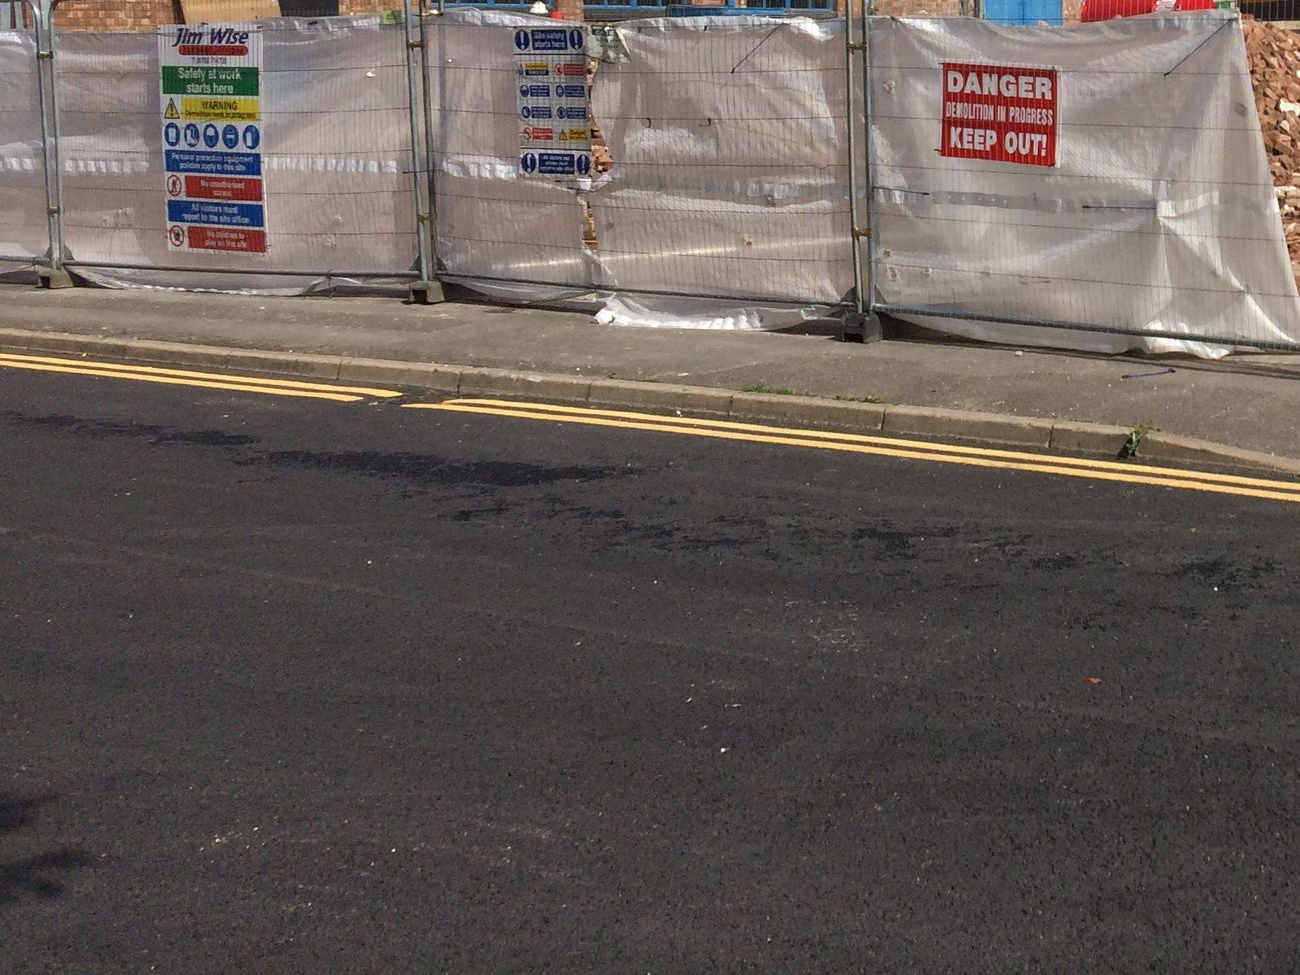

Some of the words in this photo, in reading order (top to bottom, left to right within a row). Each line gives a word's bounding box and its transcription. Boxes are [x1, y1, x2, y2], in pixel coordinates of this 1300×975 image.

[172, 28, 204, 47] Jim
[178, 68, 207, 81] Safety
[208, 68, 217, 79] at
[219, 69, 241, 80] work
[186, 83, 211, 93] starts
[213, 83, 234, 93] here
[947, 70, 1053, 100] DANGER
[201, 100, 238, 111] WARNING
[946, 101, 994, 121] DEMOLITION
[997, 105, 1006, 122] IN
[1009, 106, 1053, 126] PROGRESS
[950, 126, 998, 151] KEEP
[1005, 131, 1048, 157] OUT!
